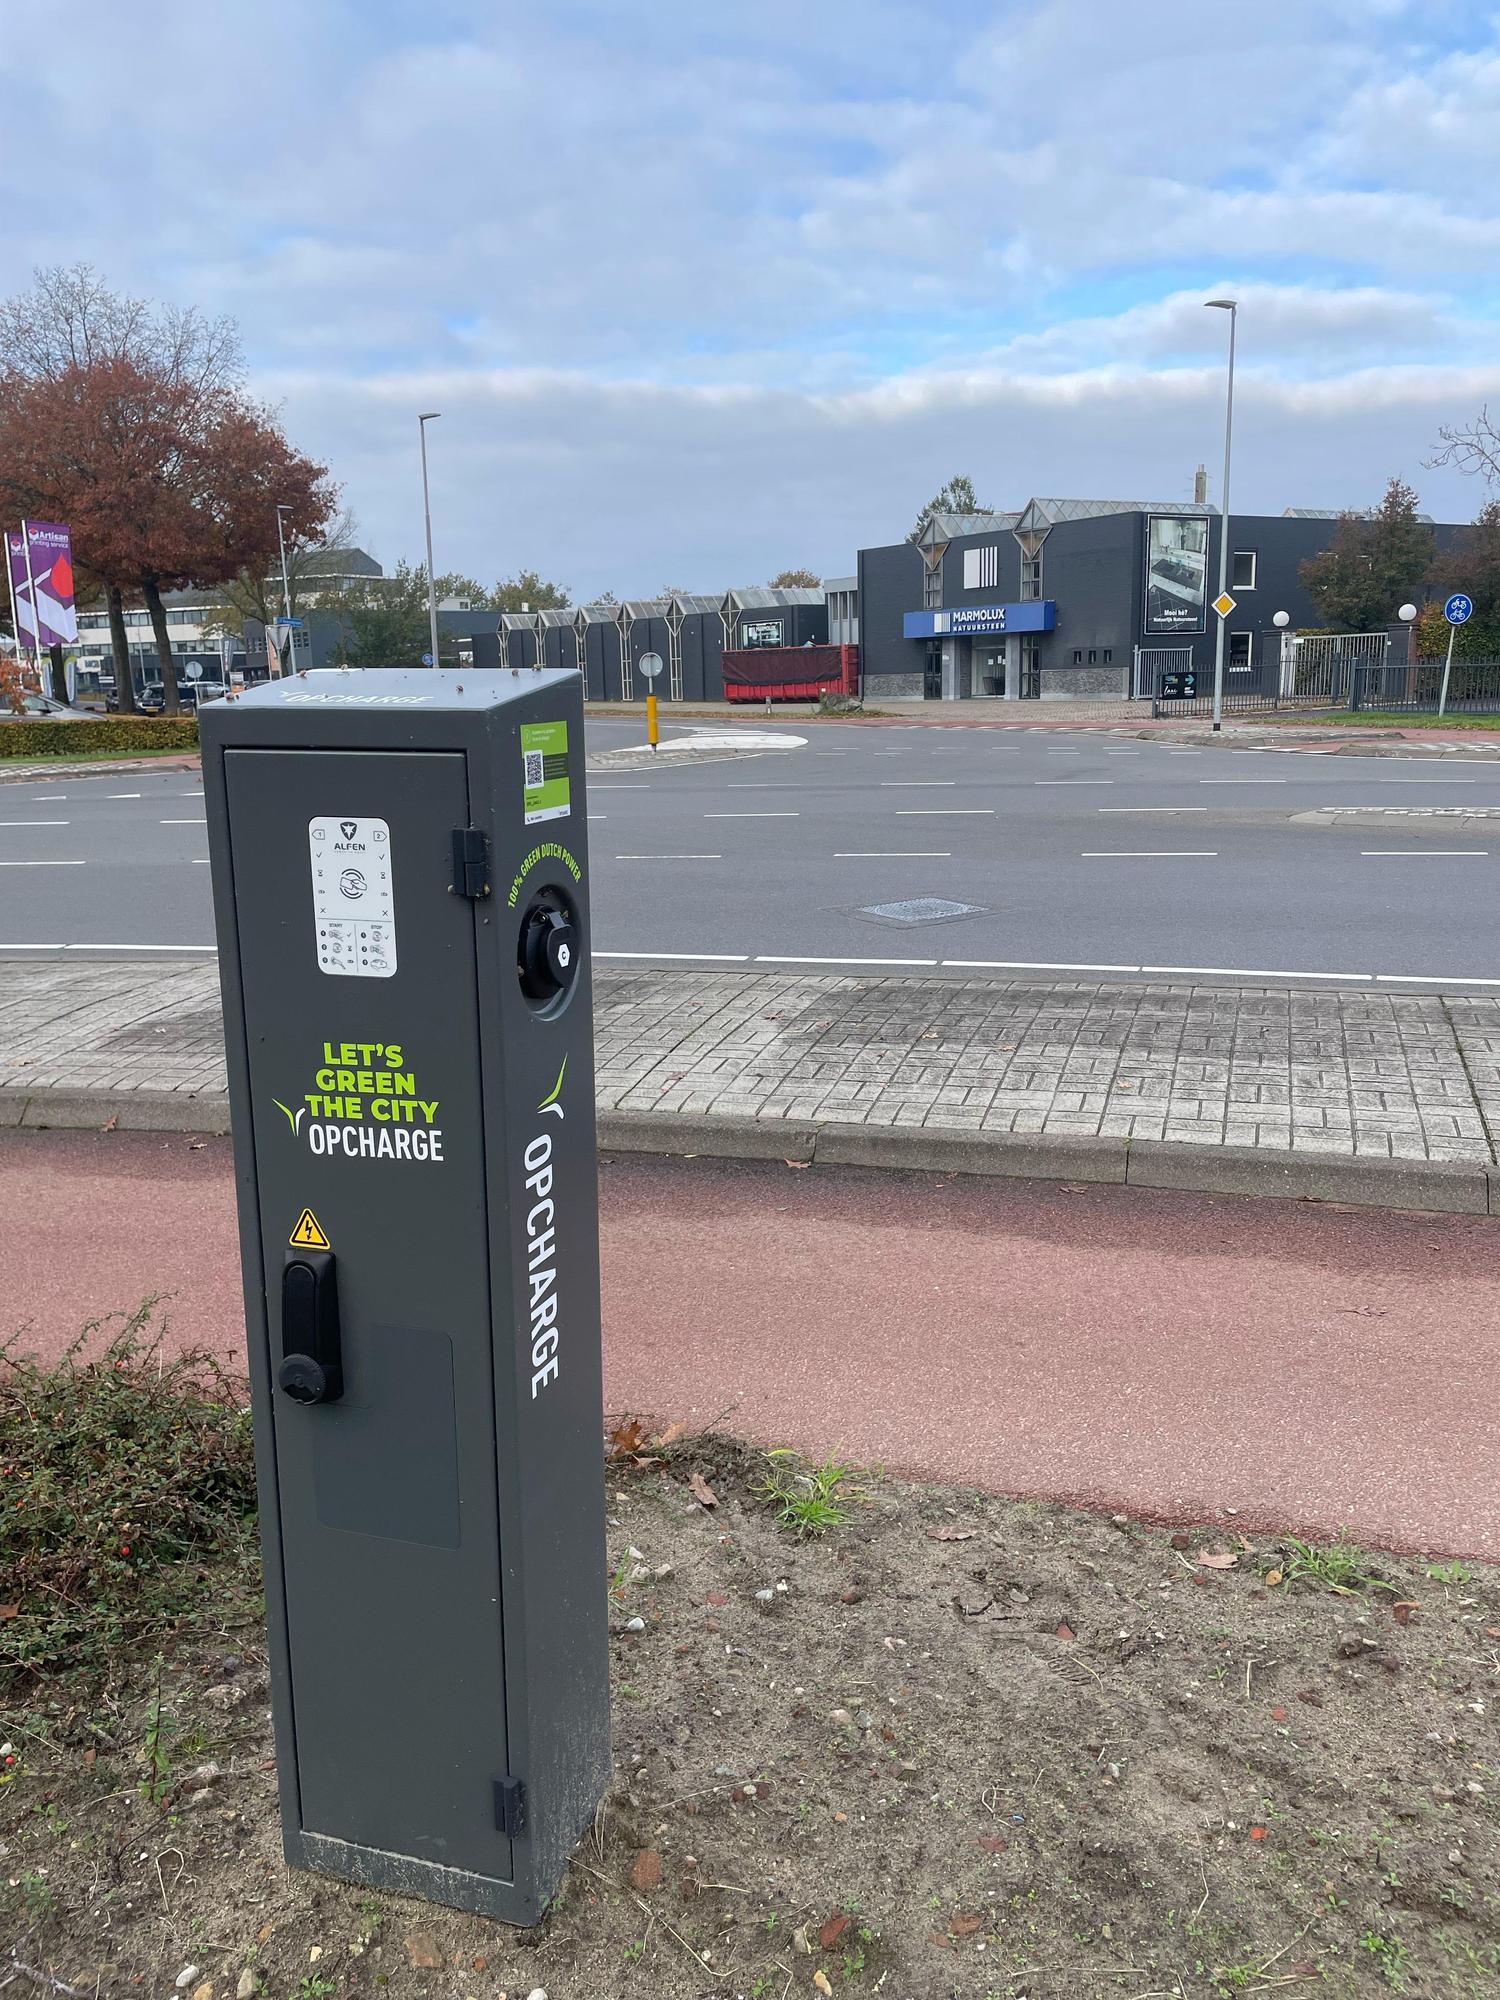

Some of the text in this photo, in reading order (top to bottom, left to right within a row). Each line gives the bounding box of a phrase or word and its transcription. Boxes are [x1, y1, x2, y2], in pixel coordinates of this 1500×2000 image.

[39, 530, 69, 543] Artisan
[952, 608, 1005, 622] MARMOLUX
[952, 622, 1005, 632] NATUURSTEEN
[285, 693, 435, 704] OPCHARGE
[334, 842, 366, 851] ALFEN
[507, 842, 582, 909] 100% GREEN DUTCH POWER
[323, 1042, 404, 1068] LET'S
[315, 1068, 416, 1096] GREEN
[304, 1094, 439, 1124] THE CITY
[308, 1123, 444, 1162] OPCHARGE
[524, 1133, 560, 1400] OPCHARGE
